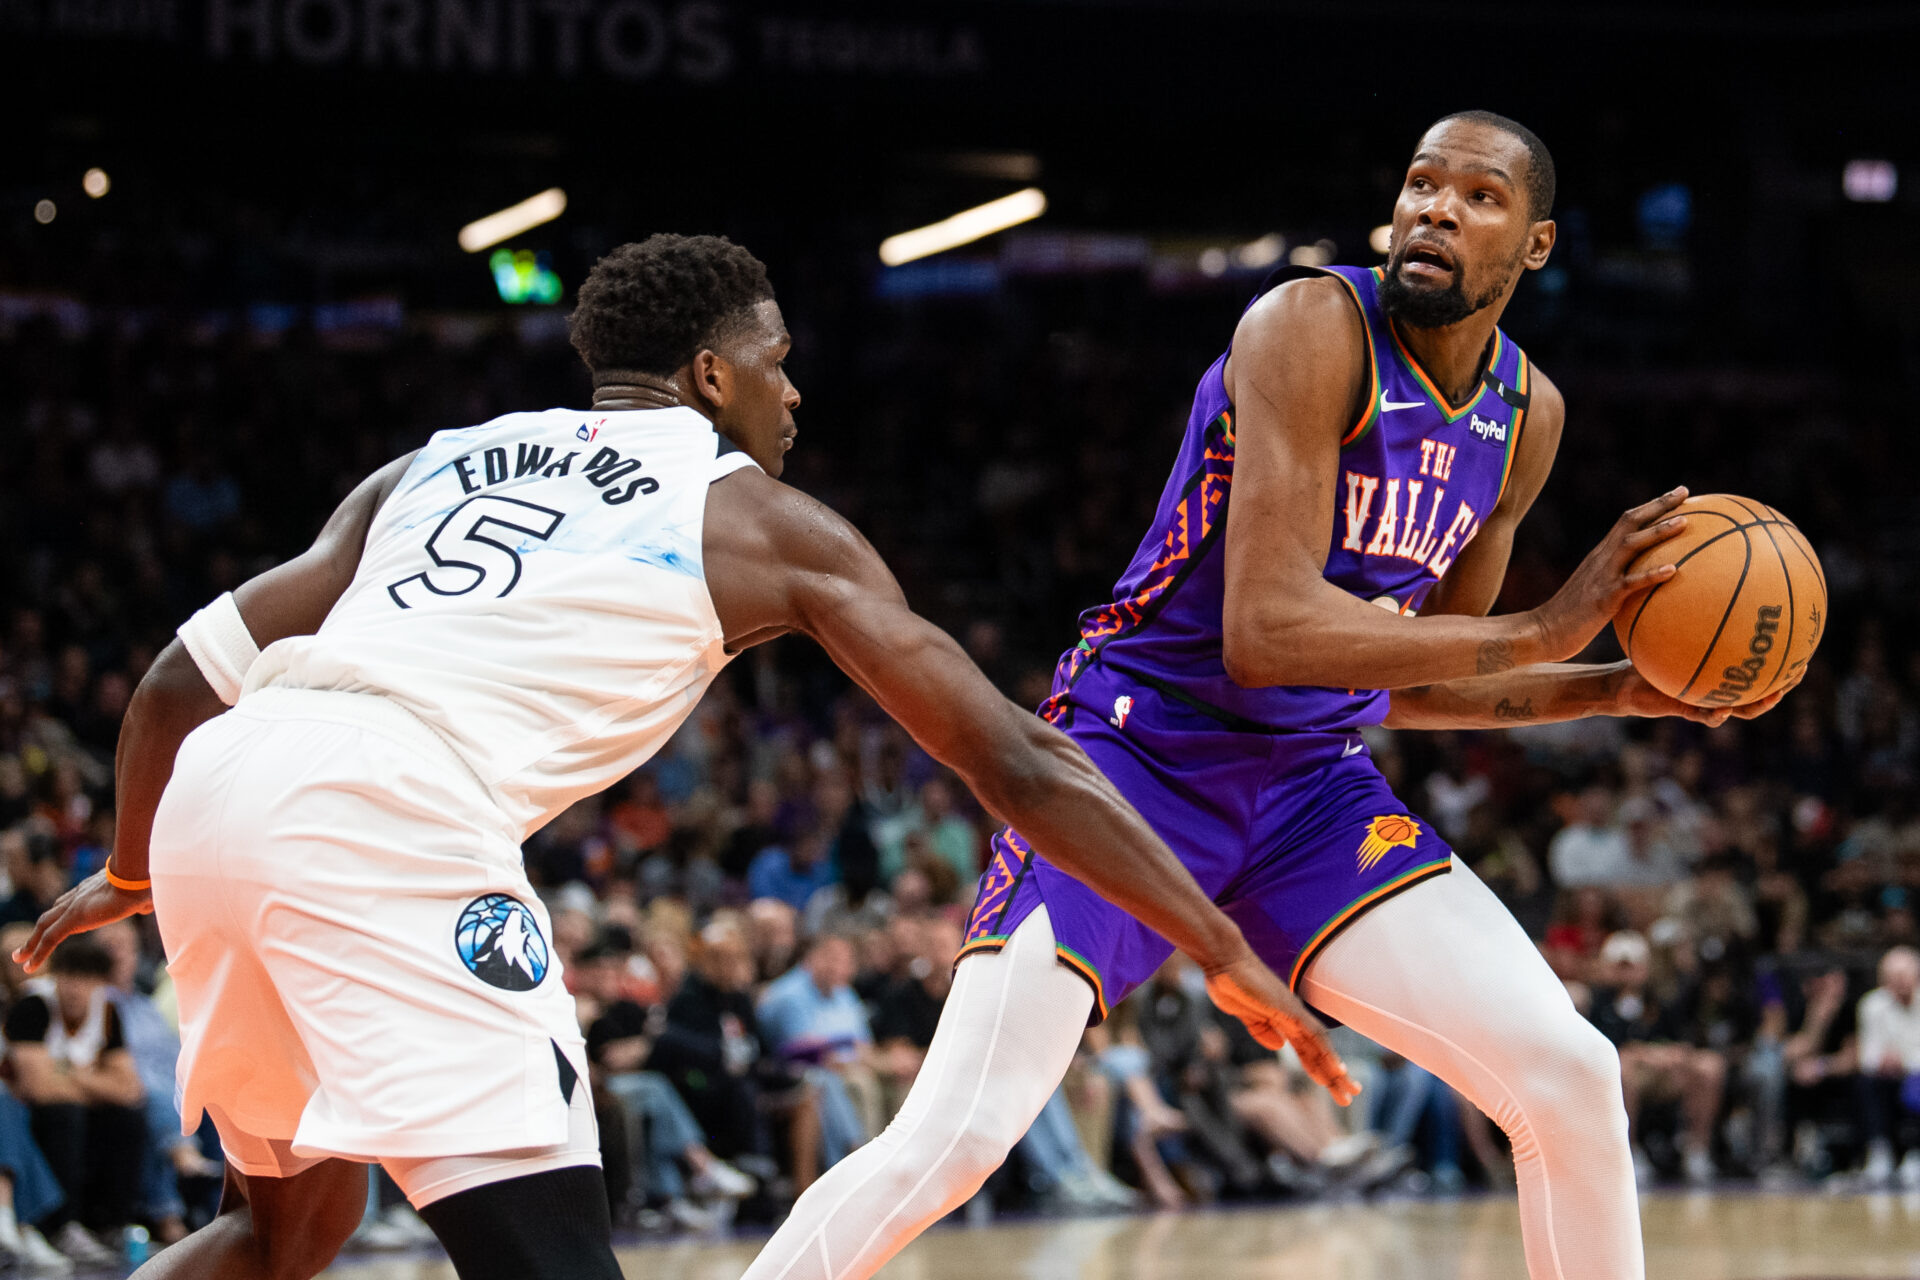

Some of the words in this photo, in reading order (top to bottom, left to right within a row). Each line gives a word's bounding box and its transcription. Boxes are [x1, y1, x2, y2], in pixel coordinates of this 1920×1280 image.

[205, 0, 735, 80] HORNITOS
[1419, 438, 1457, 482] THE
[1470, 413, 1507, 441] PayPal
[387, 495, 566, 609] 5
[1342, 470, 1480, 581] VALLE
